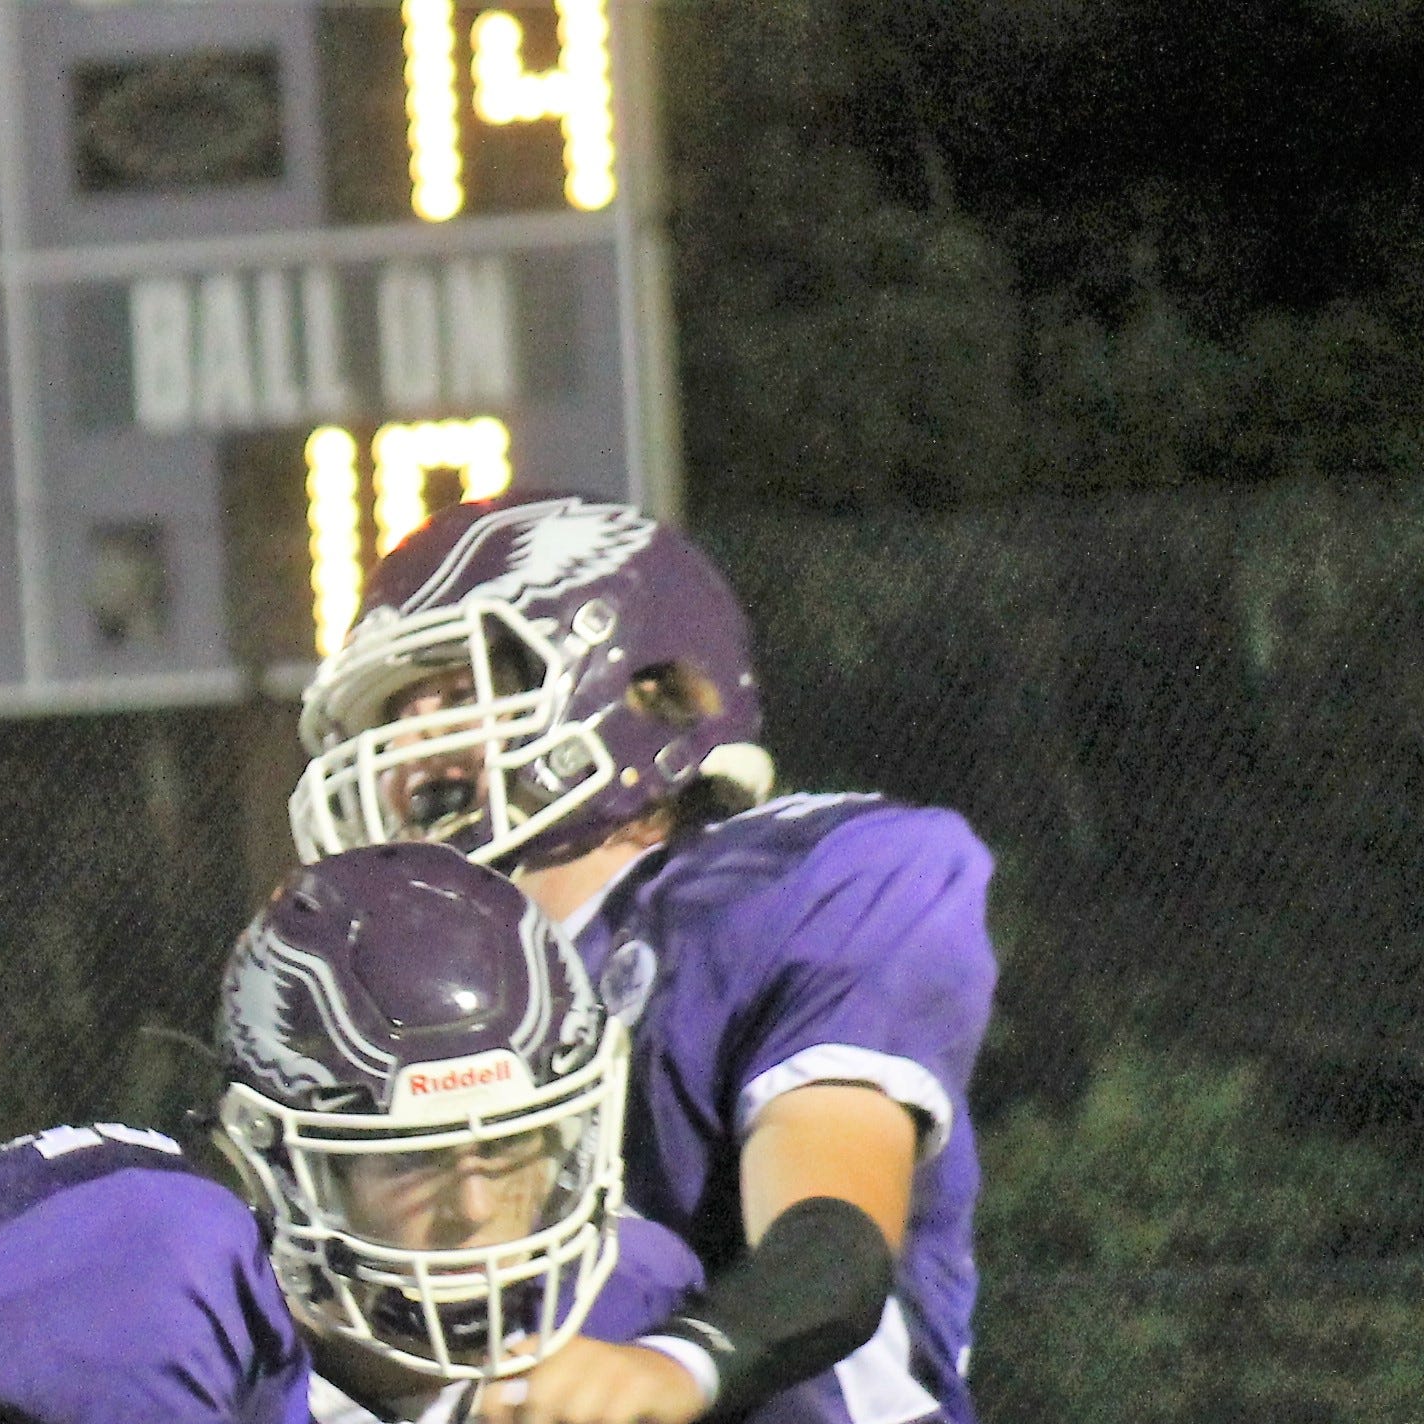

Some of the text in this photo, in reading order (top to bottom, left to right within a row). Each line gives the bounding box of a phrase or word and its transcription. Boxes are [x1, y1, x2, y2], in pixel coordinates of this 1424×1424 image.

[402, 0, 616, 222] 14
[132, 257, 516, 428] BALL ON
[411, 1060, 511, 1096] Riddell
